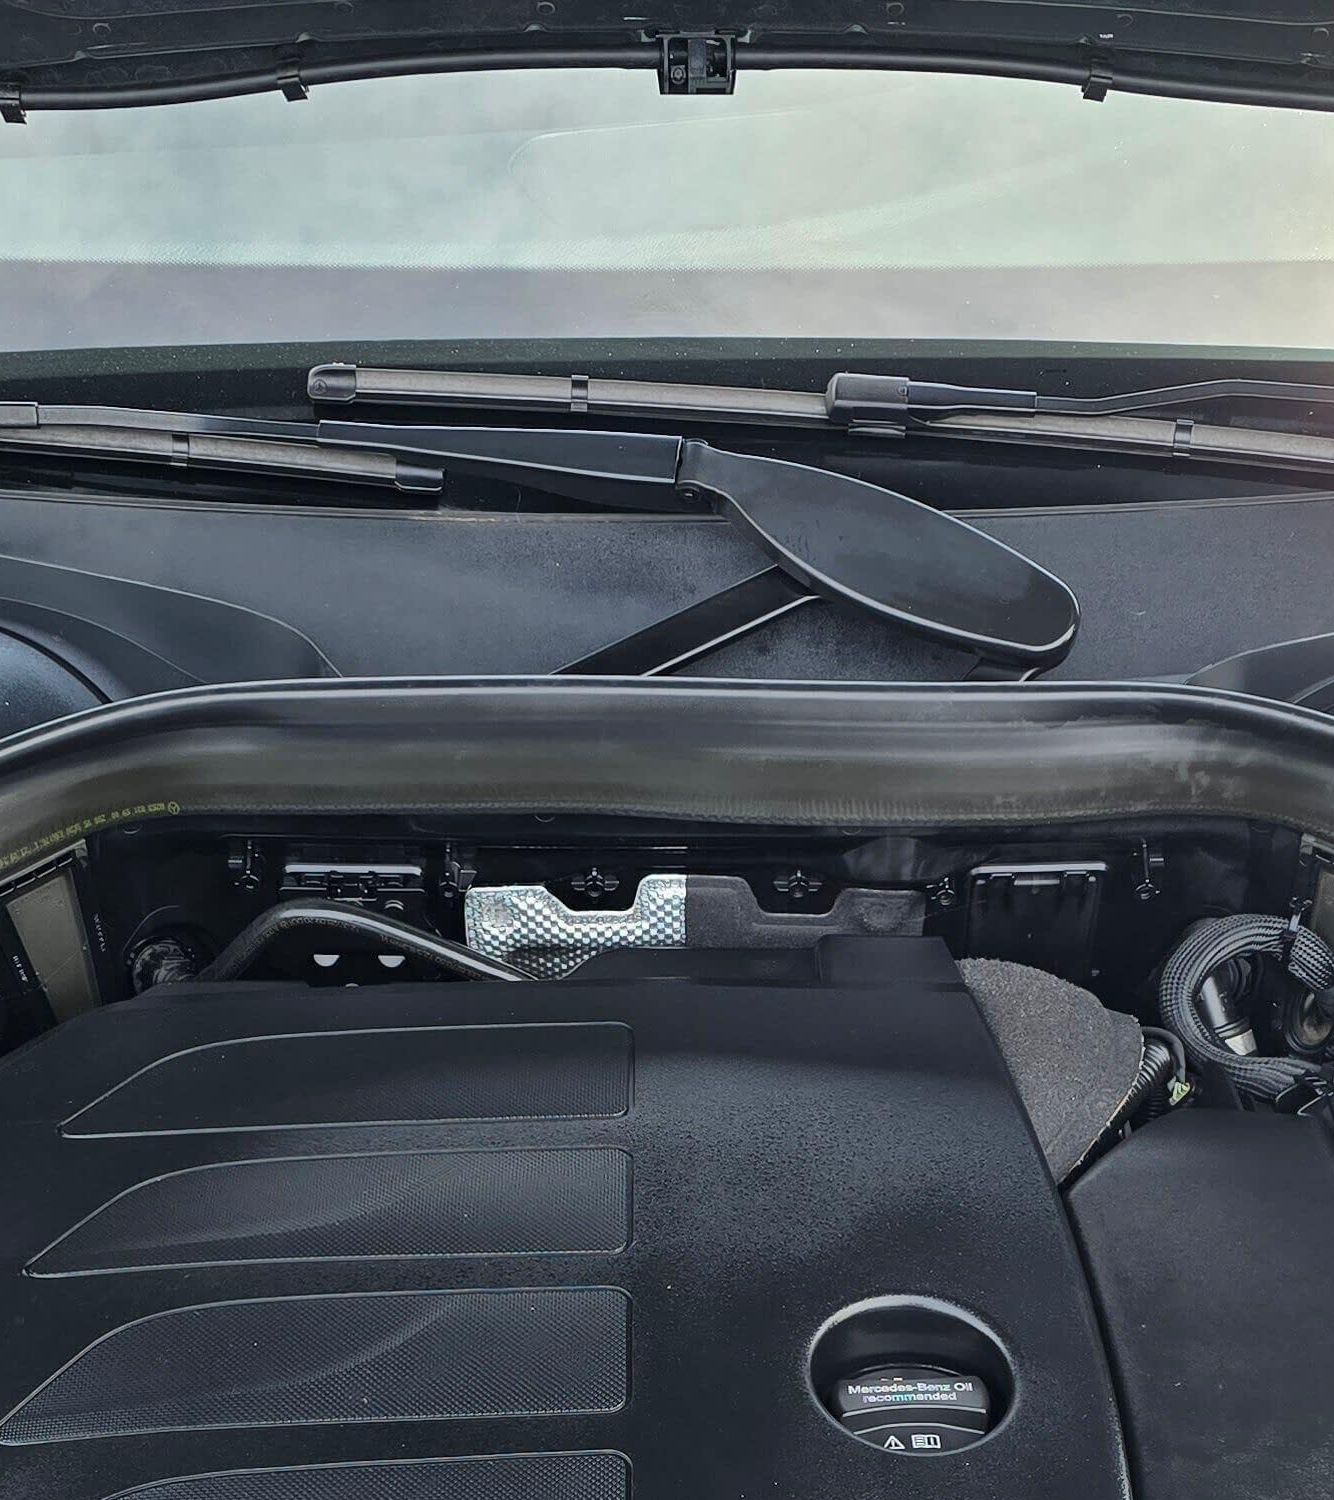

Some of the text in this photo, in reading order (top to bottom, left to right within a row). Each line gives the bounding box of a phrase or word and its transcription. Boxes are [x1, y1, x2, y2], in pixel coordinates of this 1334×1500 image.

[847, 1382, 973, 1395] Mercedes-Benz Oil
[862, 1392, 958, 1403] recommended
